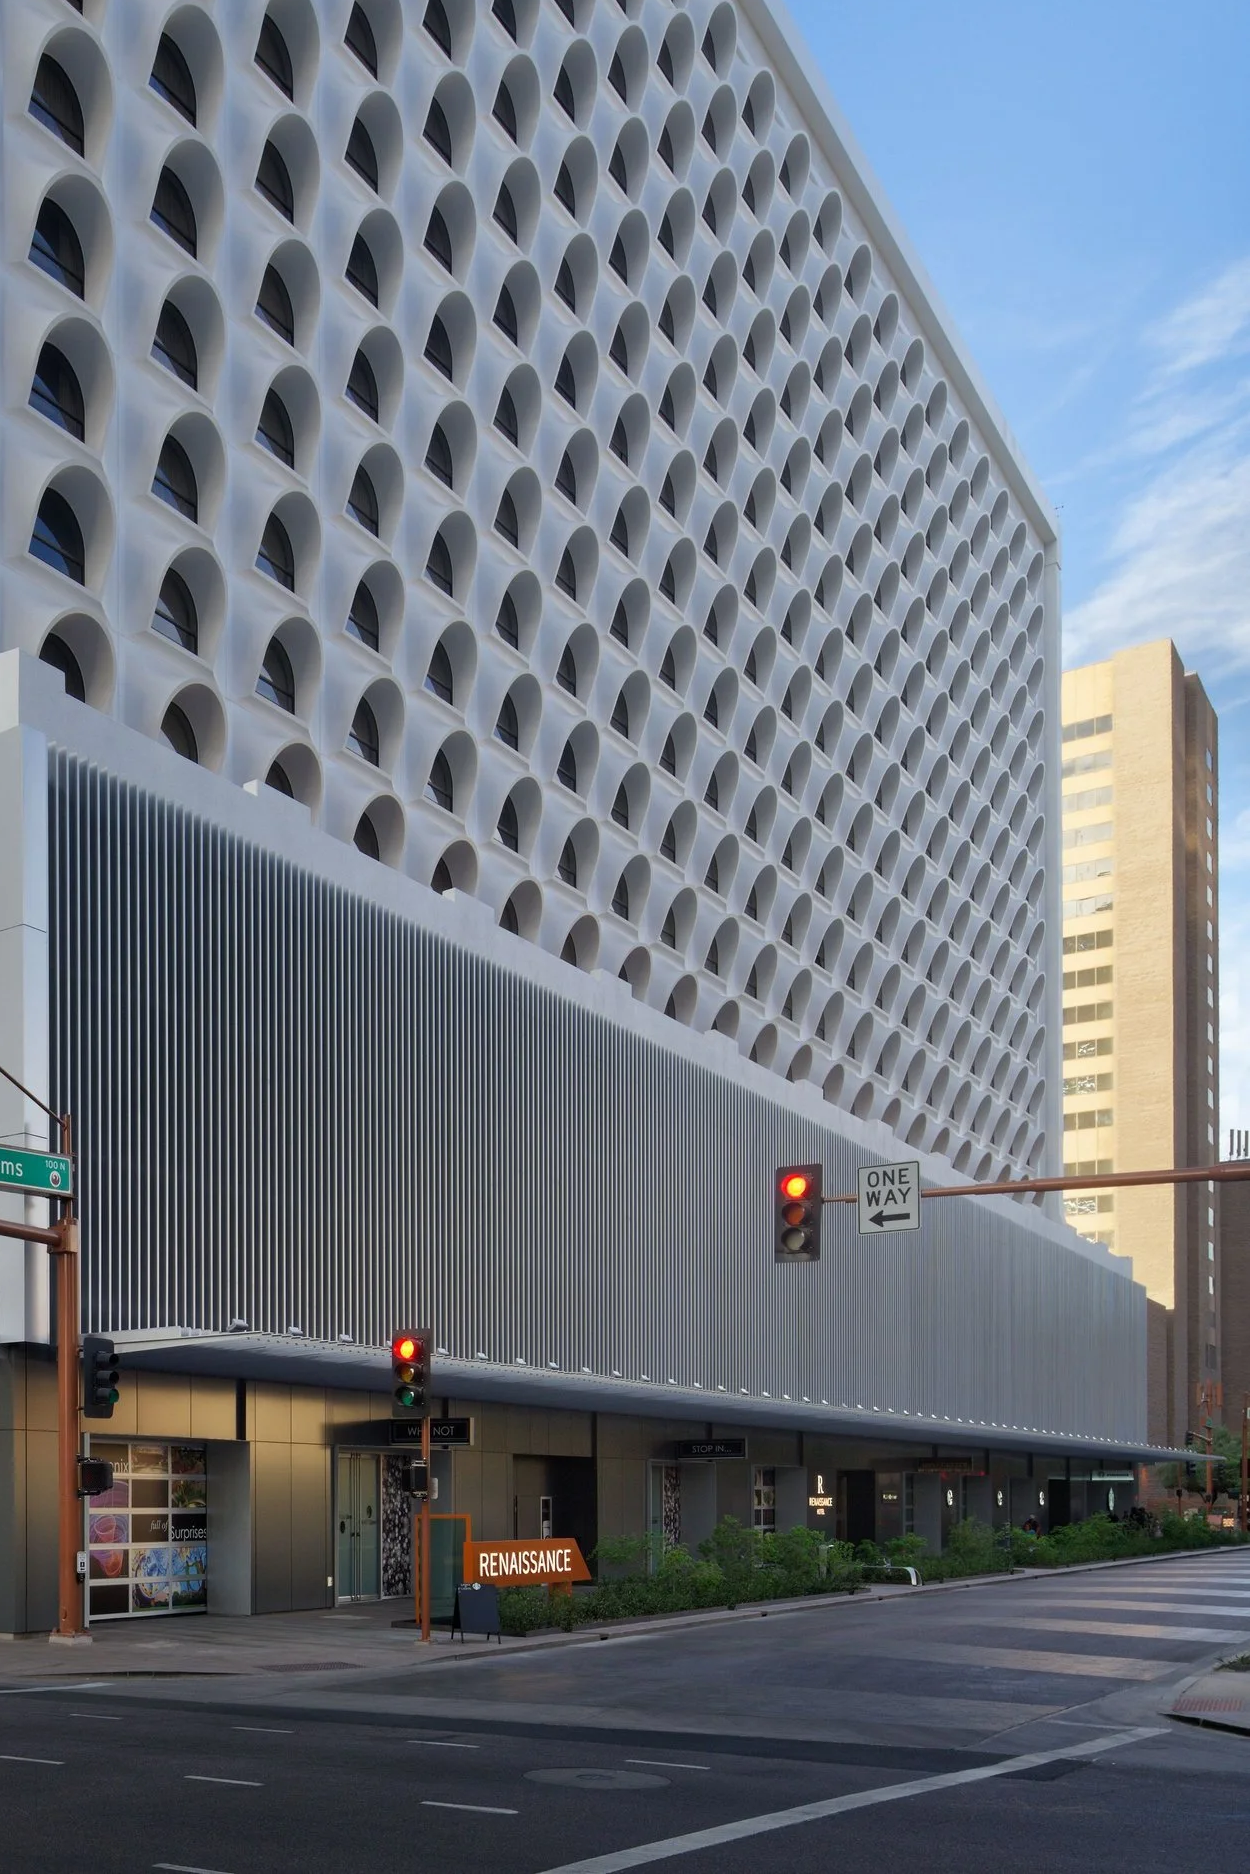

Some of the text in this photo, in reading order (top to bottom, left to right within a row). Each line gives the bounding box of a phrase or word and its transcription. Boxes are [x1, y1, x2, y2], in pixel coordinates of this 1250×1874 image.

[45, 1159, 66, 1171] 100 N
[867, 1168, 910, 1188] ONE
[866, 1187, 912, 1207] WAY
[433, 1426, 454, 1436] NOT
[692, 1445, 713, 1453] STOP
[817, 1475, 824, 1494] R
[170, 1526, 207, 1542] Surprises
[479, 1549, 572, 1577] RENAISSANCE
